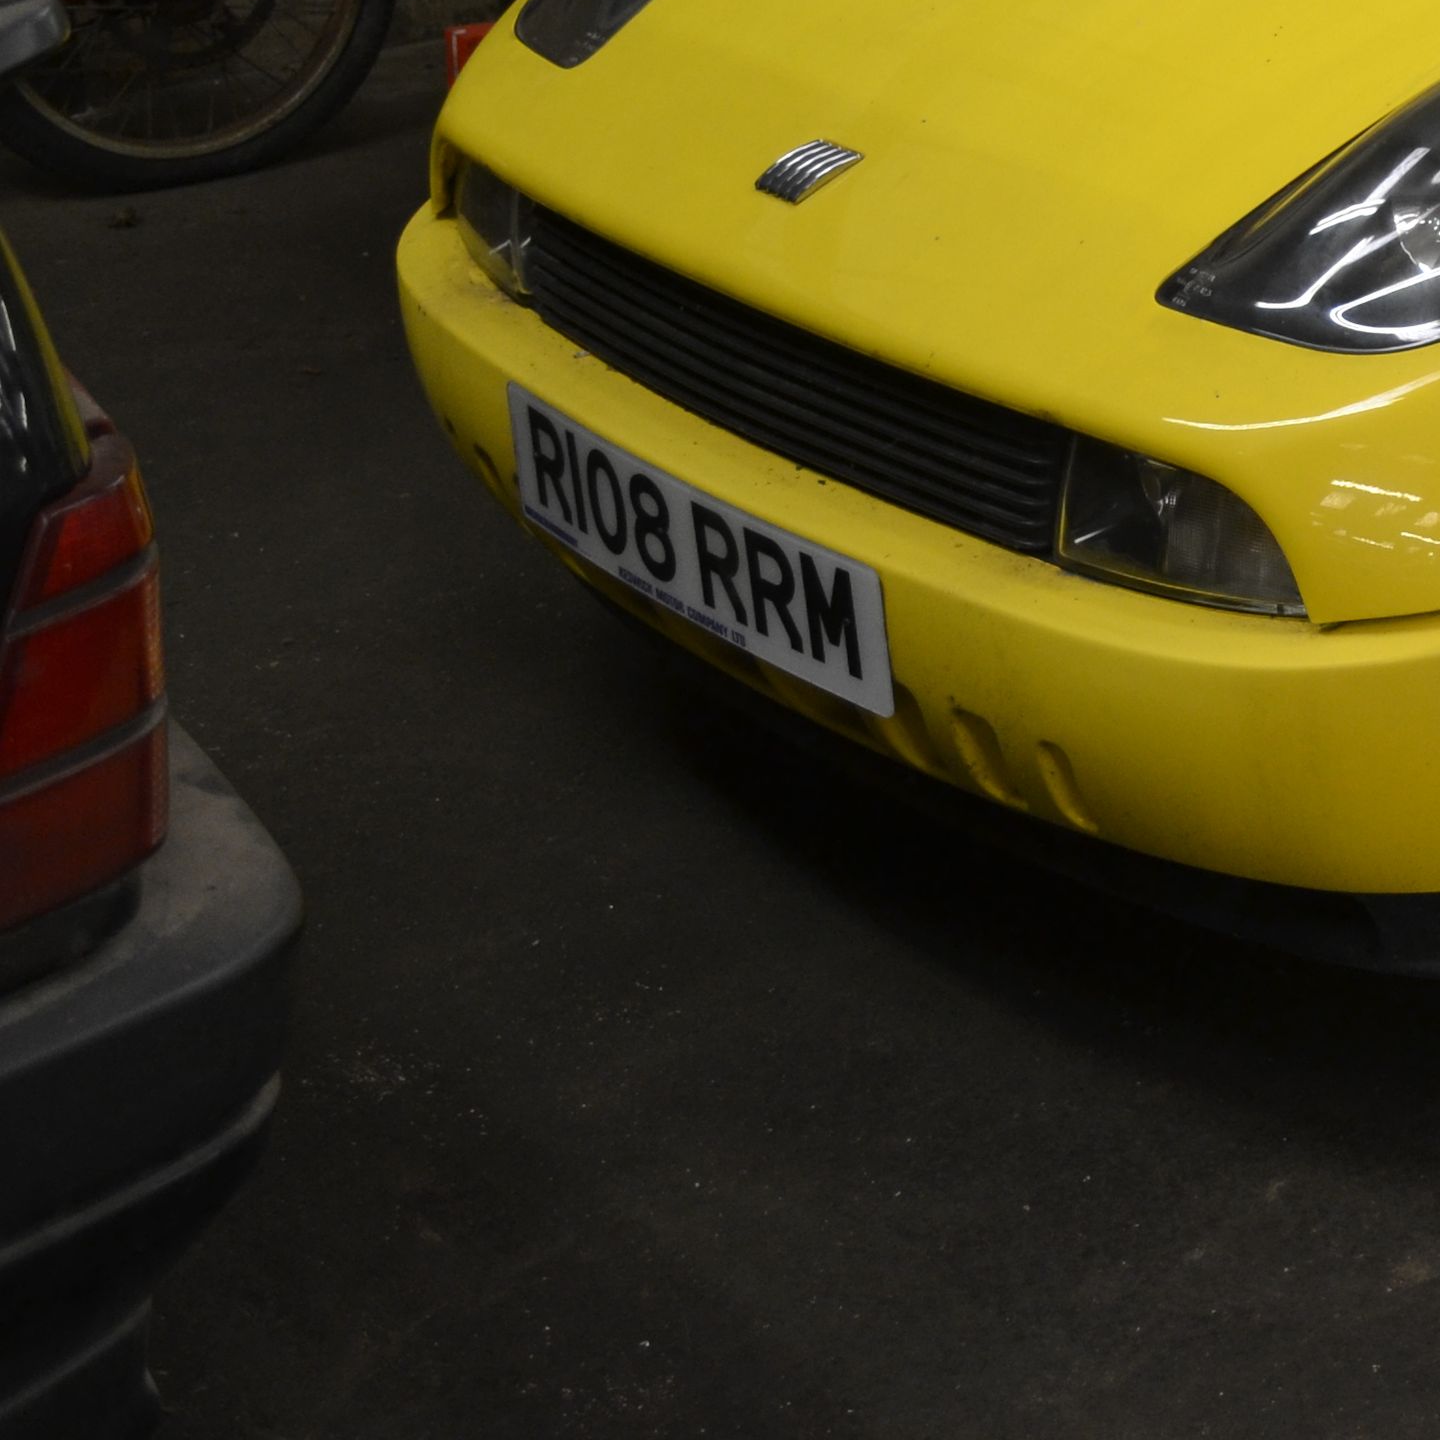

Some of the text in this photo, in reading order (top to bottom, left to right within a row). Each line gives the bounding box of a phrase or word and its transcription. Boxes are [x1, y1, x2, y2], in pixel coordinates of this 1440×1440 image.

[527, 405, 863, 680] R108 RRM
[687, 606, 729, 638] COMPANY
[731, 629, 747, 647] LTD
